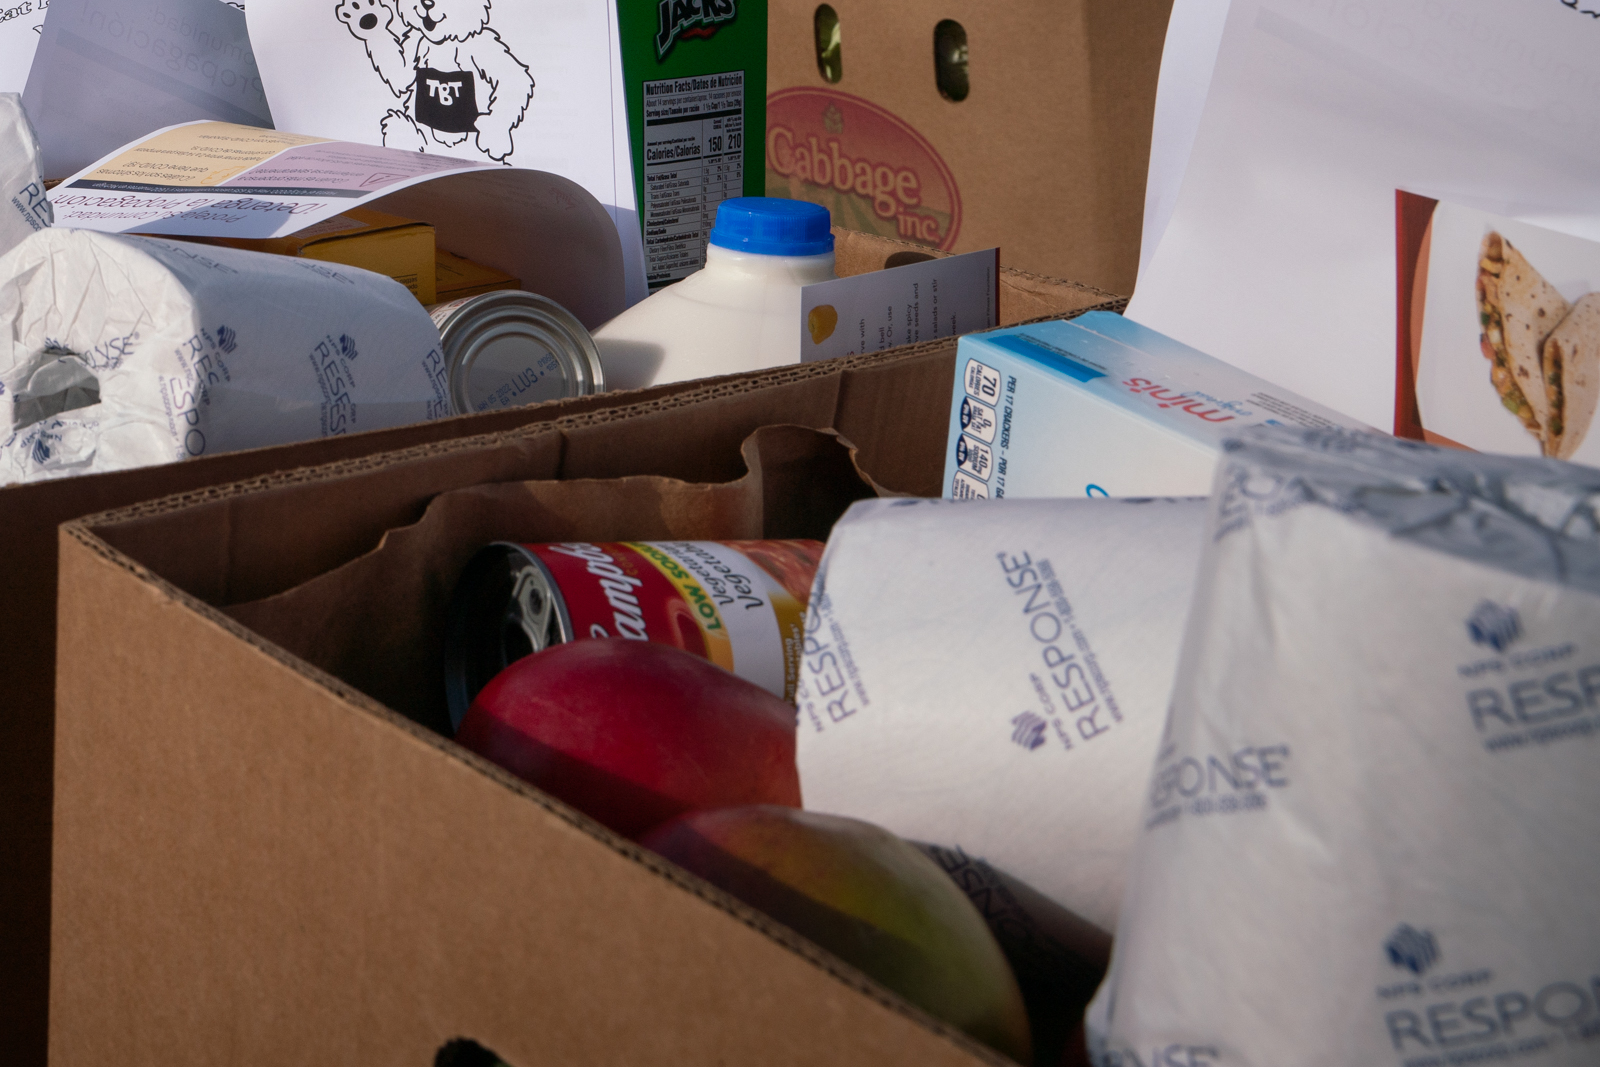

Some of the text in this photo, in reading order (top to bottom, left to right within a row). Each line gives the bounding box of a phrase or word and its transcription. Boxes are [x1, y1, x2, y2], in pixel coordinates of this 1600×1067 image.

[426, 79, 463, 107] TBT
[646, 73, 742, 96] Nutrition Facts/Datos de Nutrición
[709, 136, 721, 152] 150
[728, 133, 741, 150] 210
[767, 126, 919, 218] Cabbage
[51, 195, 185, 211] Propagación!
[62, 209, 248, 224] Proteja Su Comunidad:
[187, 197, 210, 209] la
[898, 206, 941, 243] inc.
[511, 367, 538, 393] LU3
[973, 364, 983, 397] CALORIES
[981, 375, 997, 398] 70
[1122, 377, 1236, 423] minis
[997, 375, 1017, 488] PER 17 CRACKERS POR 17
[683, 584, 722, 630] LOW
[1028, 671, 1073, 751] NPS CORP
